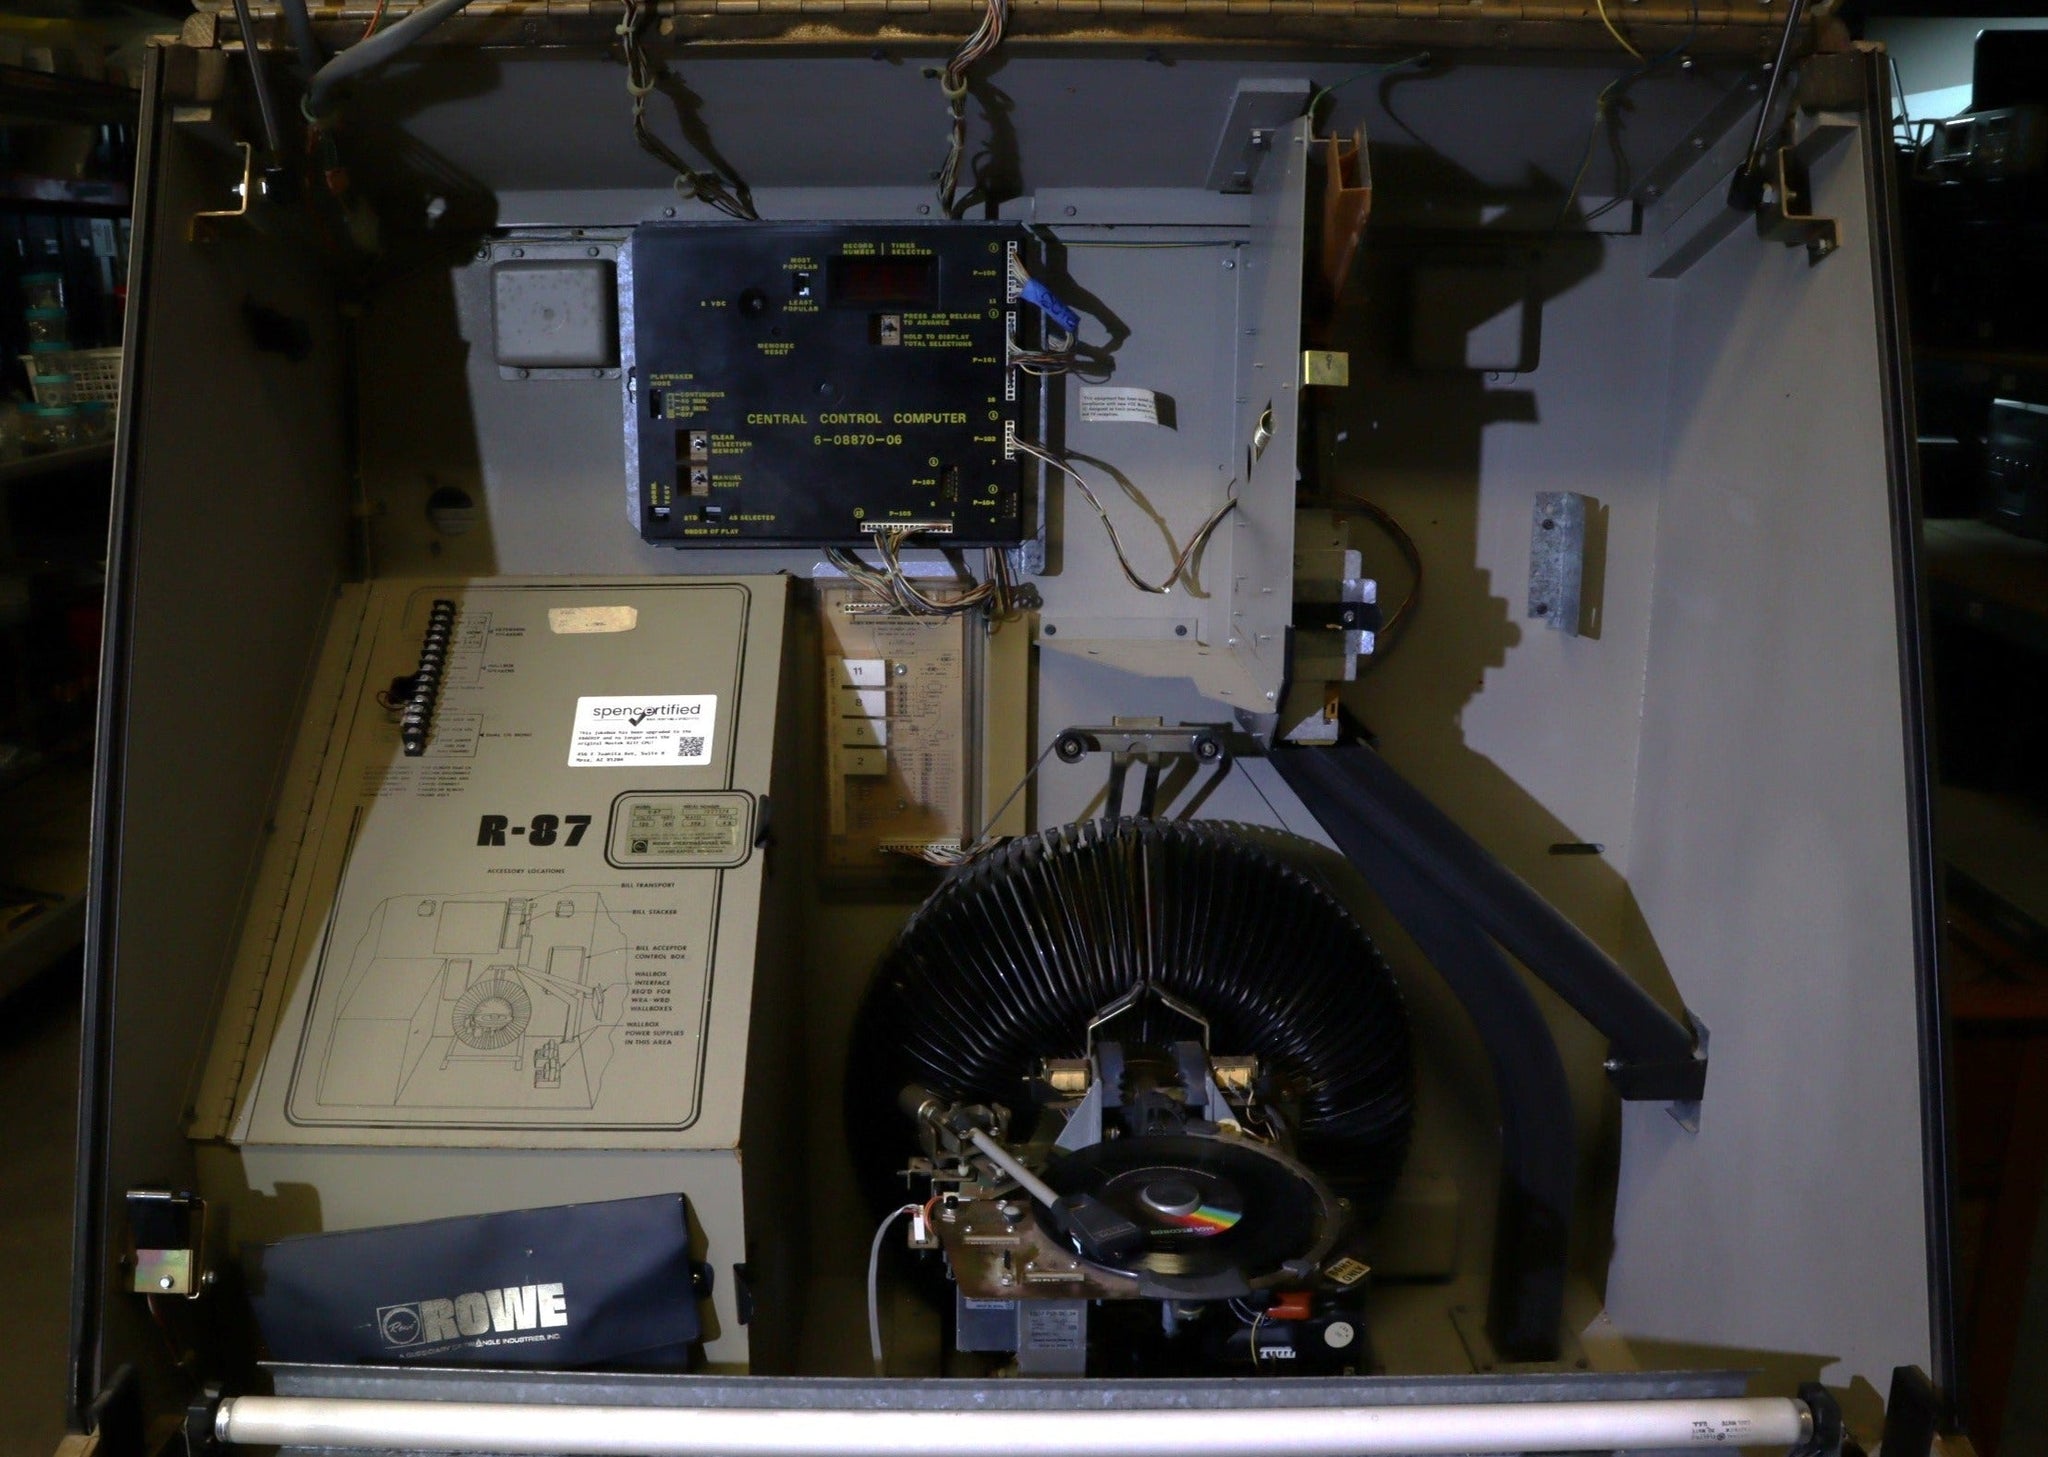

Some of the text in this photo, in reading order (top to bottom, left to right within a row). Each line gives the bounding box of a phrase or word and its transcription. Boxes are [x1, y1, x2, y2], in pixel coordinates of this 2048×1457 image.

[747, 413, 967, 424] CENTRAL CONTROL COMPUTER
[813, 434, 903, 445] 6-08870-06
[853, 667, 863, 676] 11
[593, 704, 701, 719] spencertified
[857, 727, 864, 736] 5
[476, 813, 593, 847] R-87
[421, 1283, 568, 1343] ROWE
